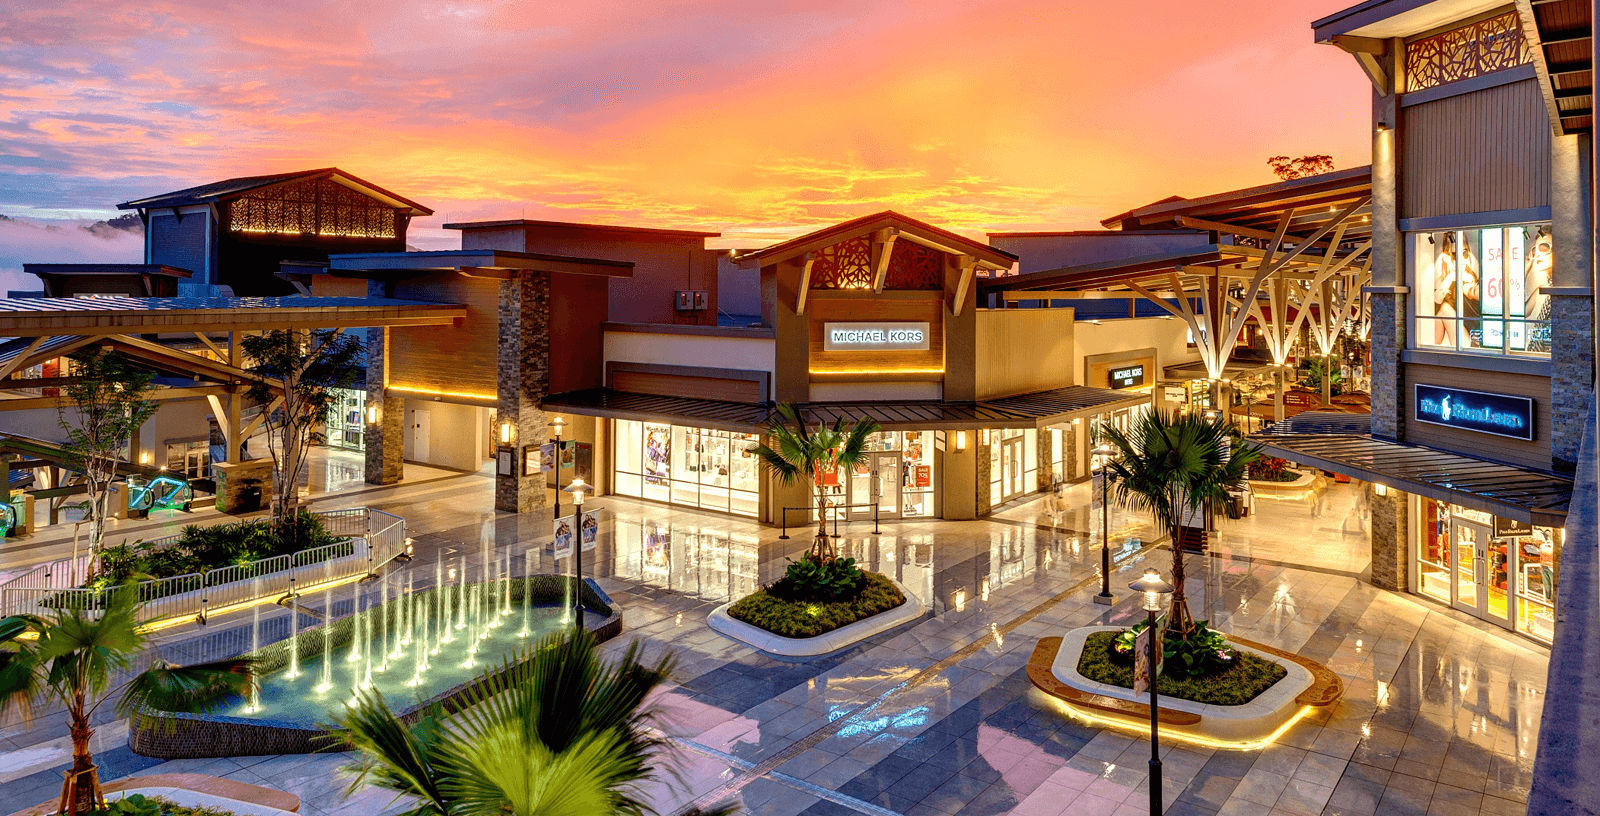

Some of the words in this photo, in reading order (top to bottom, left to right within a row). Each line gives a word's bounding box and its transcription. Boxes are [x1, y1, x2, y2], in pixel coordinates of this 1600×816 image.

[1488, 247, 1519, 261] SAE
[833, 331, 886, 342] MICHAEL
[889, 331, 923, 341] KORS
